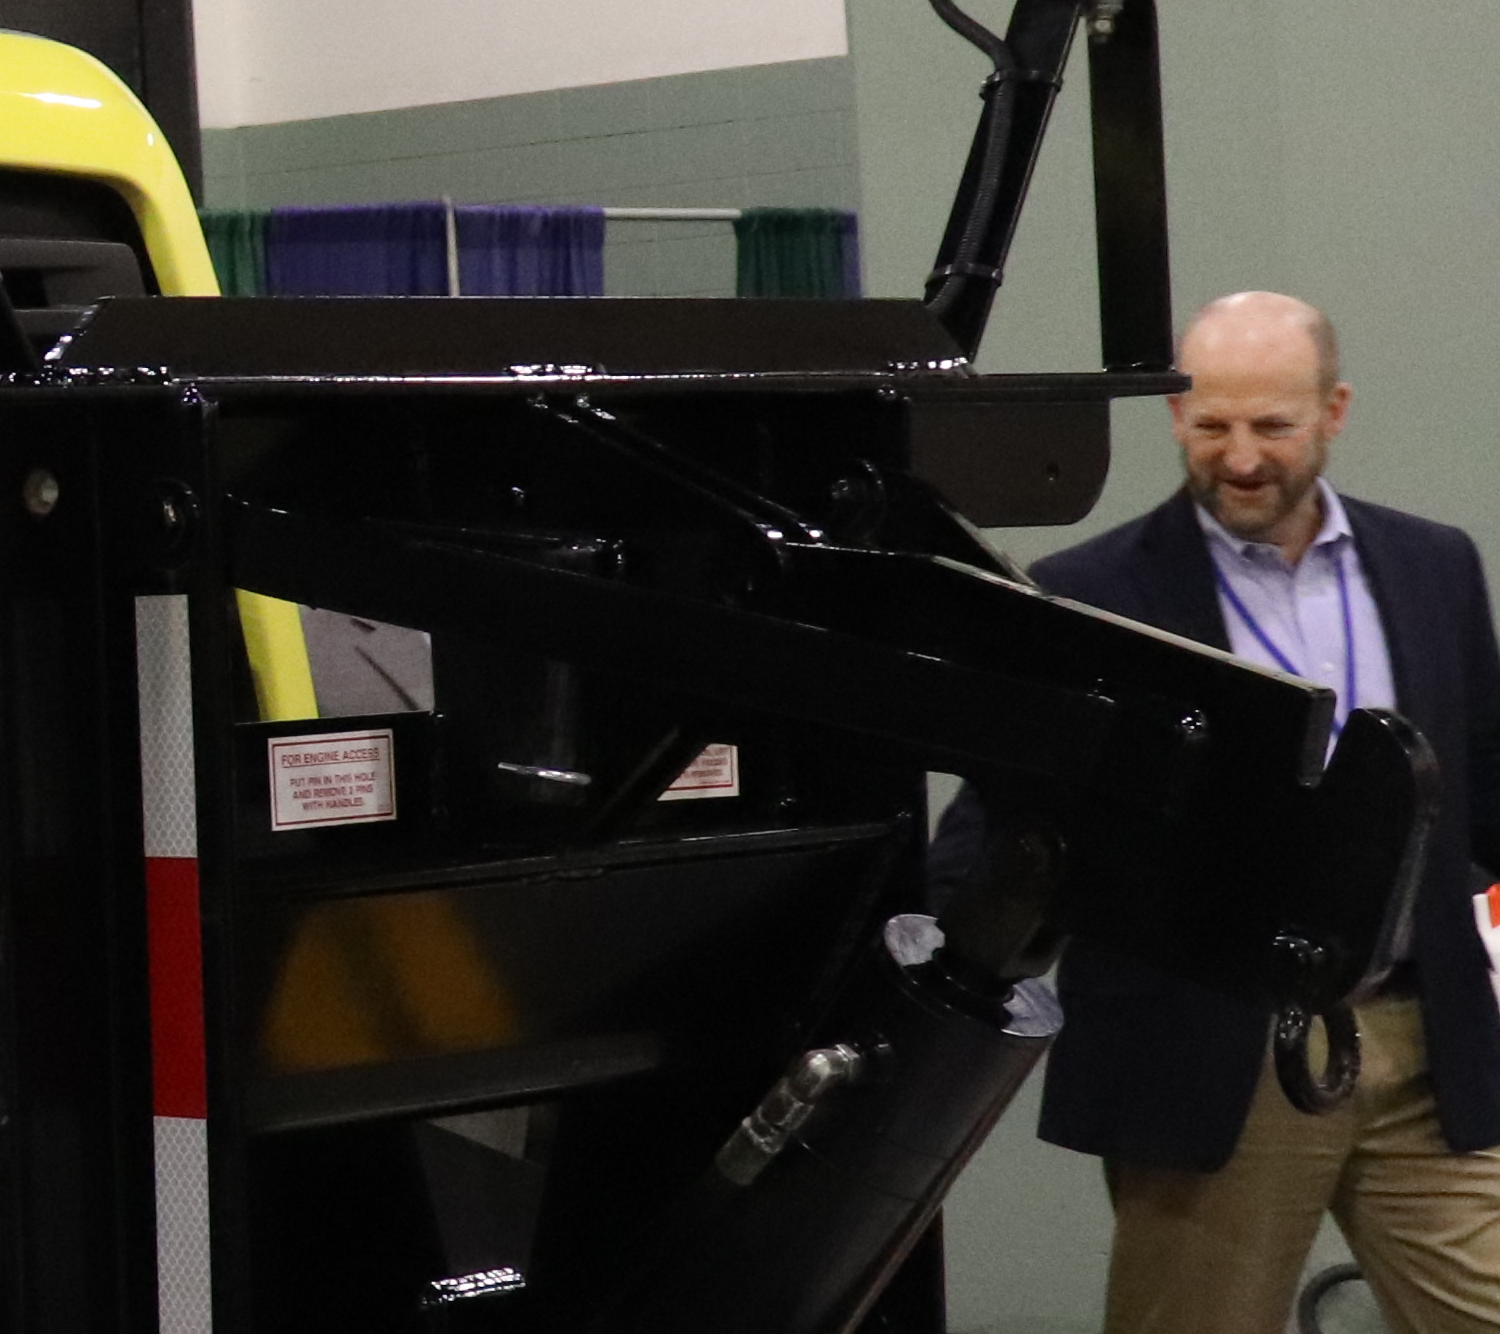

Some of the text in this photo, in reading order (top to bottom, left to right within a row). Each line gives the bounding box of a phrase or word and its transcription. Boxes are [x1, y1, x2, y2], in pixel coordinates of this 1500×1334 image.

[282, 748, 380, 766] FOR ENGINE ACCESS
